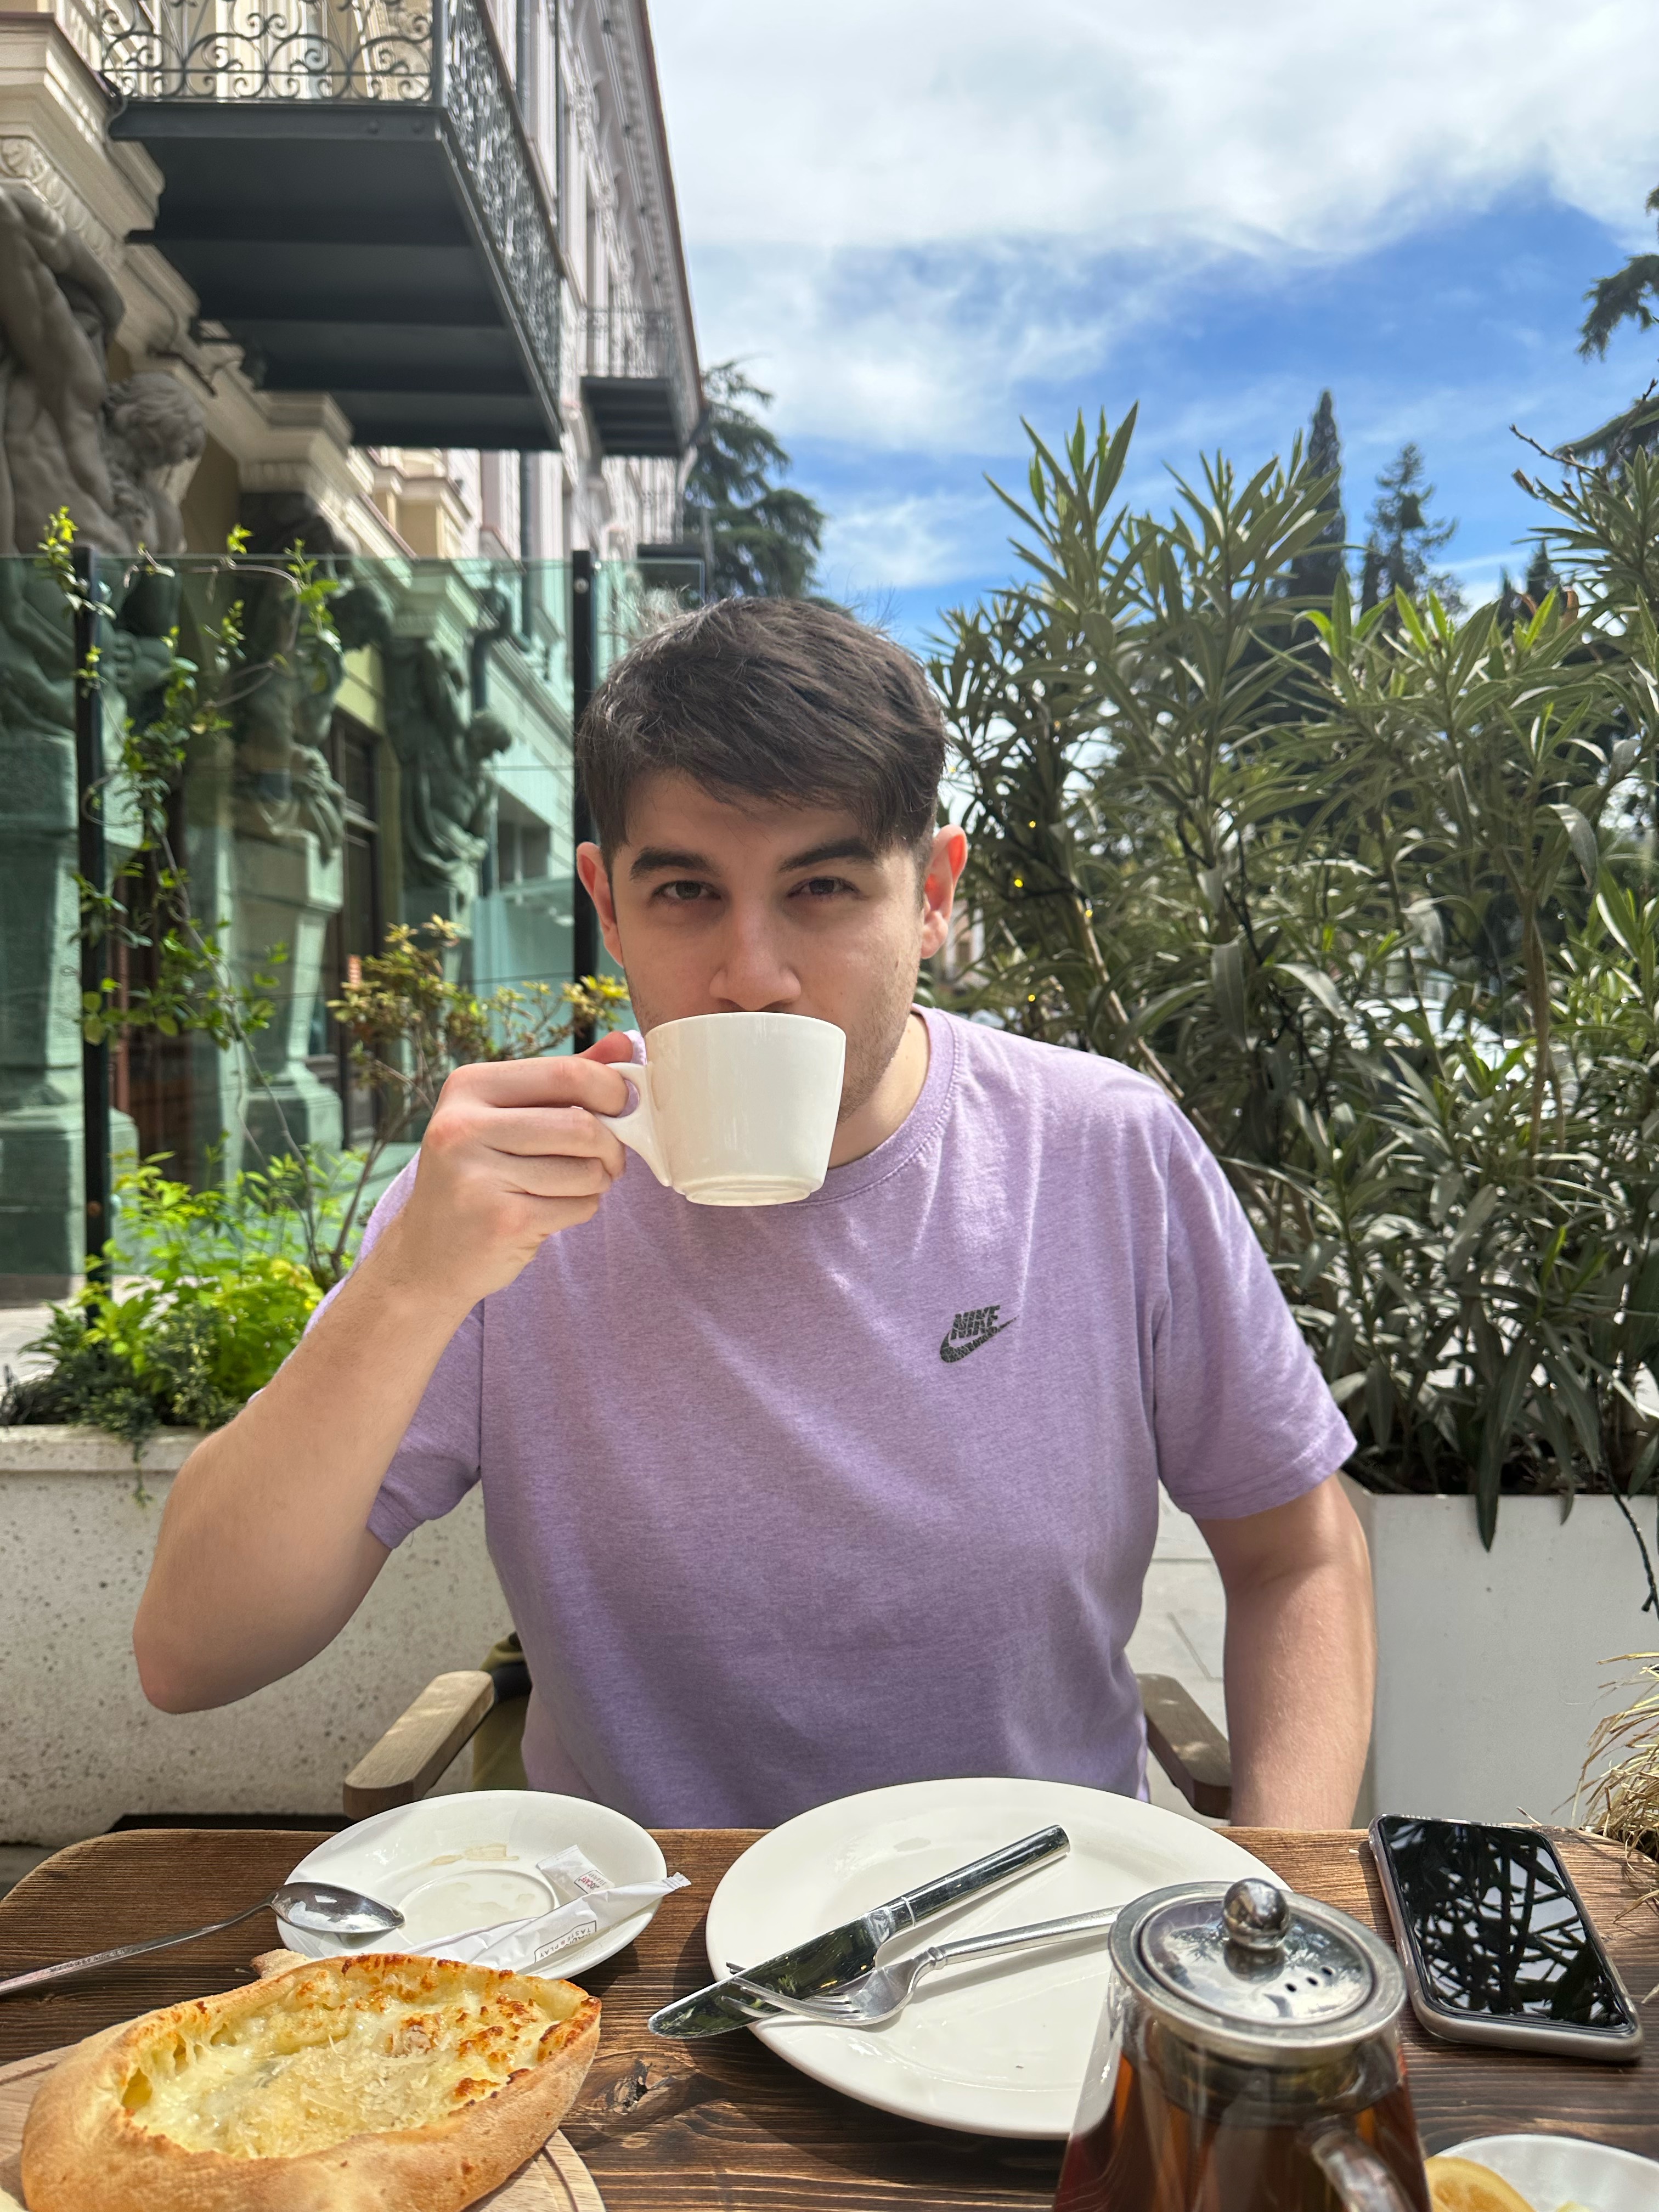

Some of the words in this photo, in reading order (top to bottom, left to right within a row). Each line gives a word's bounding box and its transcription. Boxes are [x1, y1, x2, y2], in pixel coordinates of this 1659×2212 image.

[950, 1305, 1000, 1340] NIKE
[567, 1928, 591, 1942] TASTE
[540, 1944, 559, 1958] PLAY
